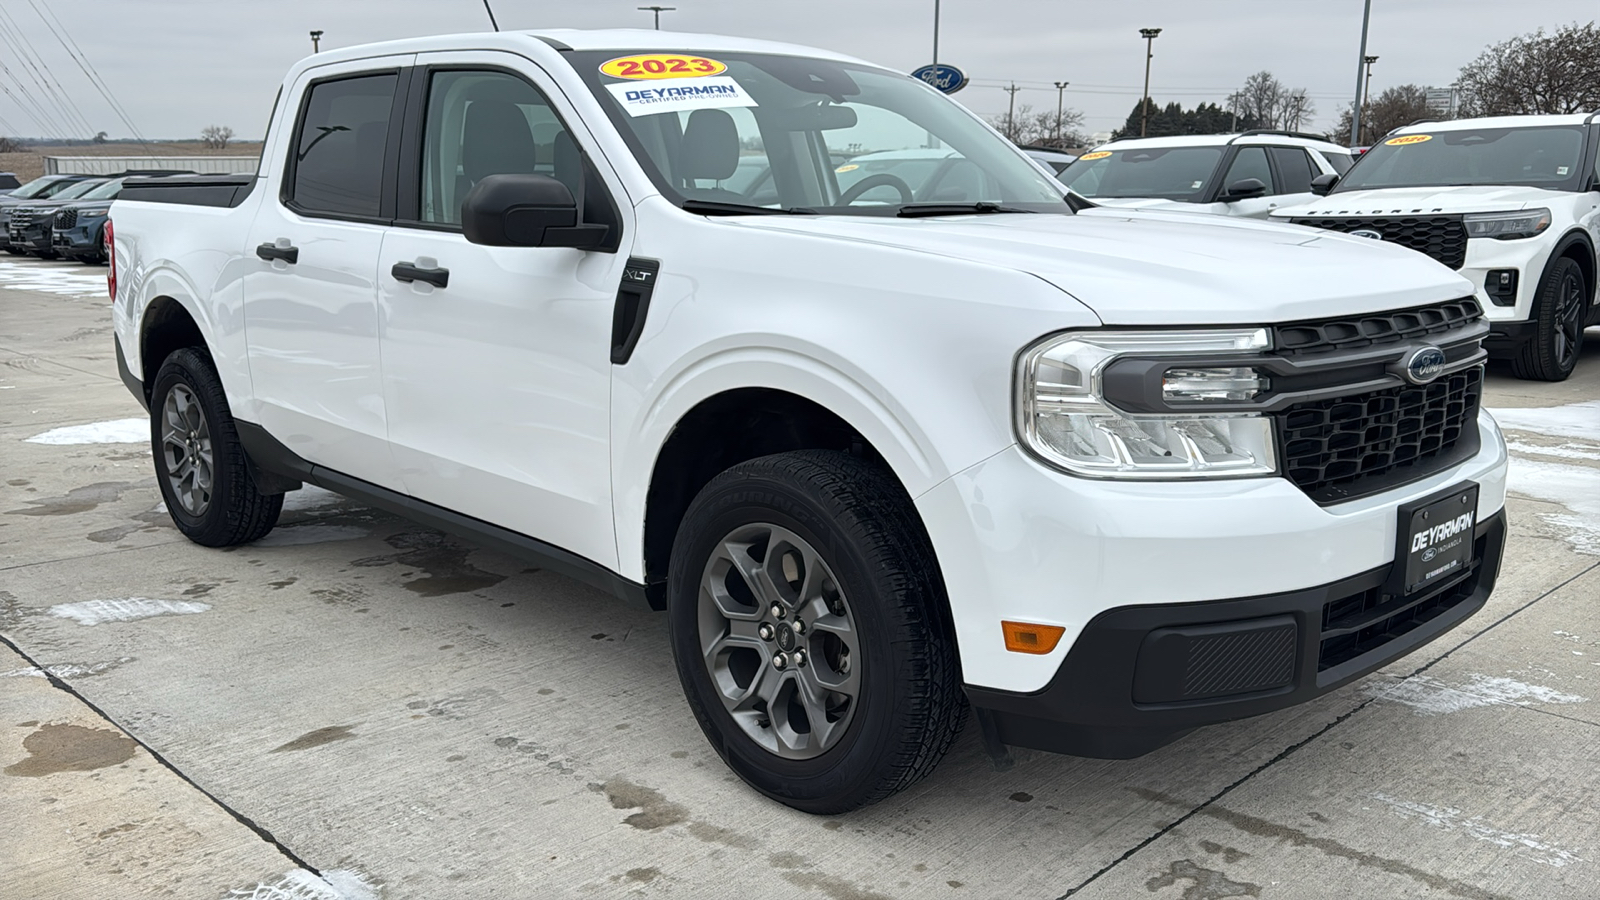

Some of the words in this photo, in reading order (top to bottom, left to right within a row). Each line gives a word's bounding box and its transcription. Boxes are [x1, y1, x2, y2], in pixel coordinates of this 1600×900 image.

[617, 59, 716, 76] 2023
[625, 85, 736, 102] DEYARMAN
[638, 96, 686, 105] CERTIFIED
[688, 93, 739, 101] PRE-OWNED
[1307, 208, 1443, 216] EXPLORER
[623, 269, 652, 281] XLT
[1411, 510, 1474, 554] DEYARMAN
